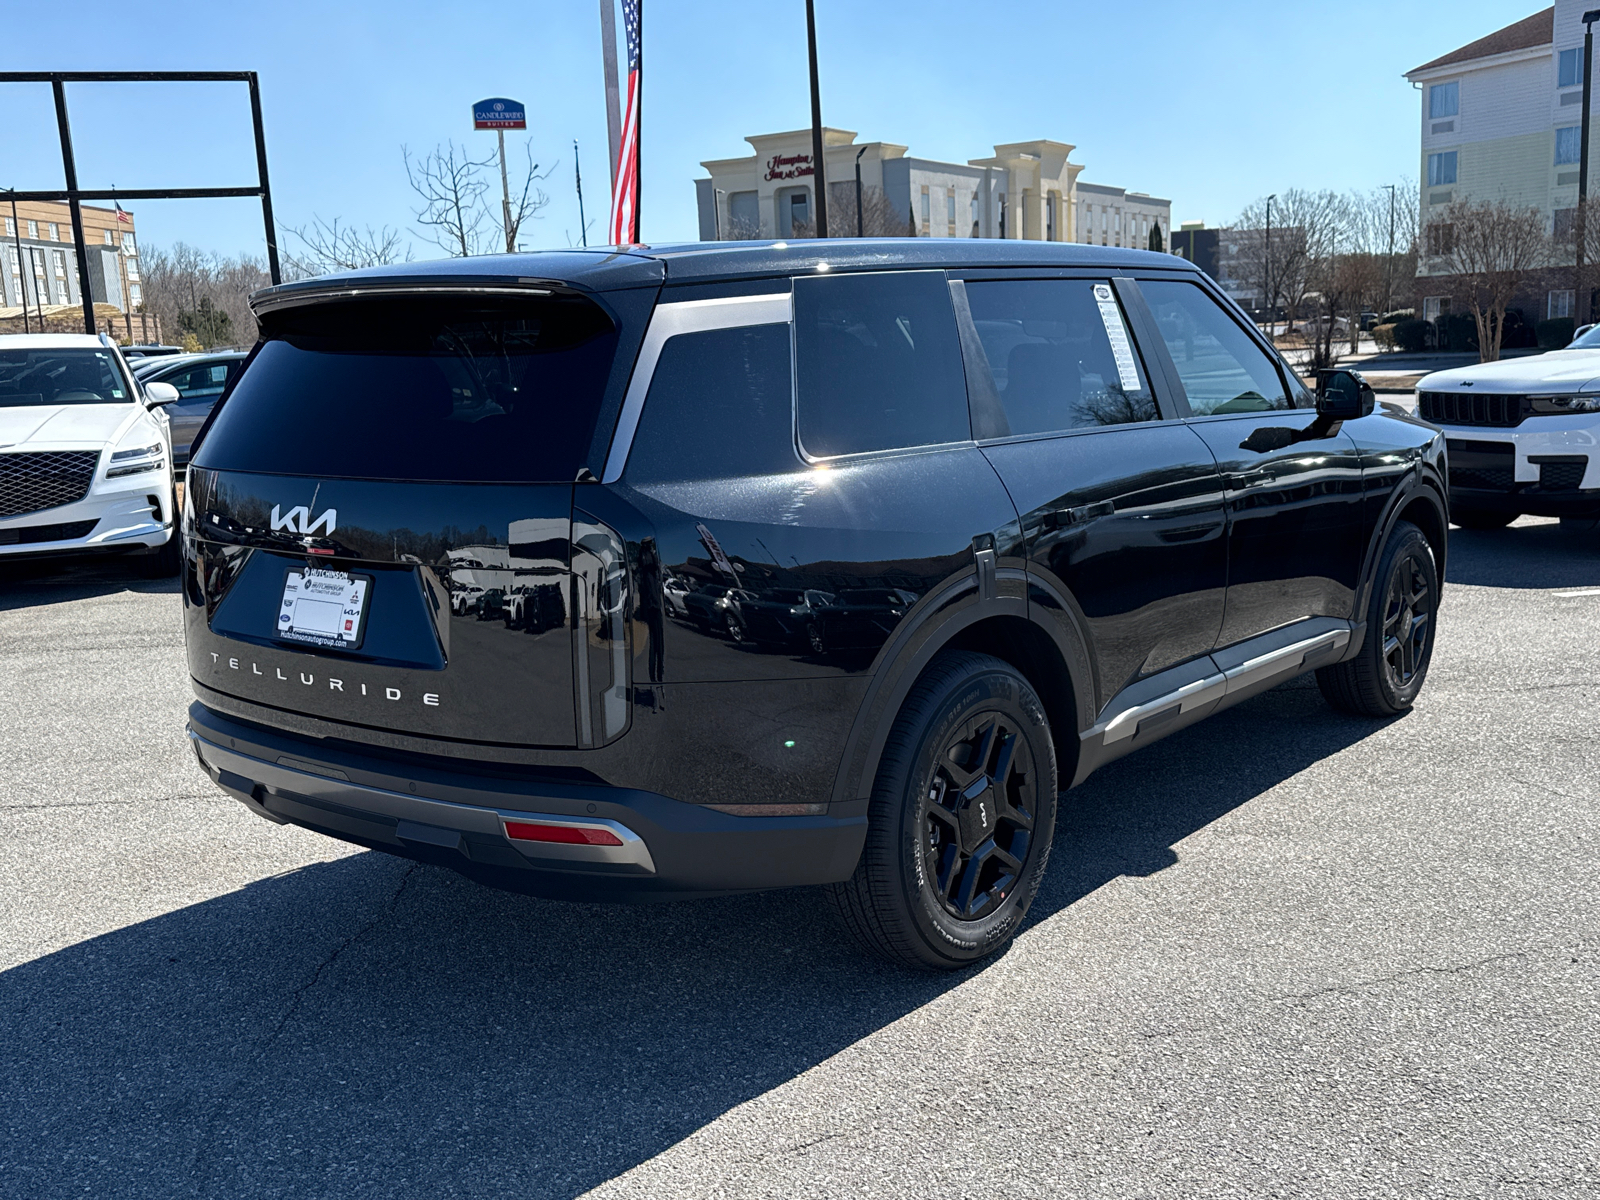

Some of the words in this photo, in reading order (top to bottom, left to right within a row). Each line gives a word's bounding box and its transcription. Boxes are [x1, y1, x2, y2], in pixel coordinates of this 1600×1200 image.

[475, 111, 524, 119] CANDLEWOOD
[767, 153, 813, 170] Hampton
[764, 169, 786, 181] Inn
[270, 503, 337, 537] KIA
[311, 568, 348, 580] HUTCHINSON
[343, 608, 360, 616] KIA
[280, 631, 347, 648] Hutchinsonautogroup.com
[210, 652, 440, 706] TELLURIDE
